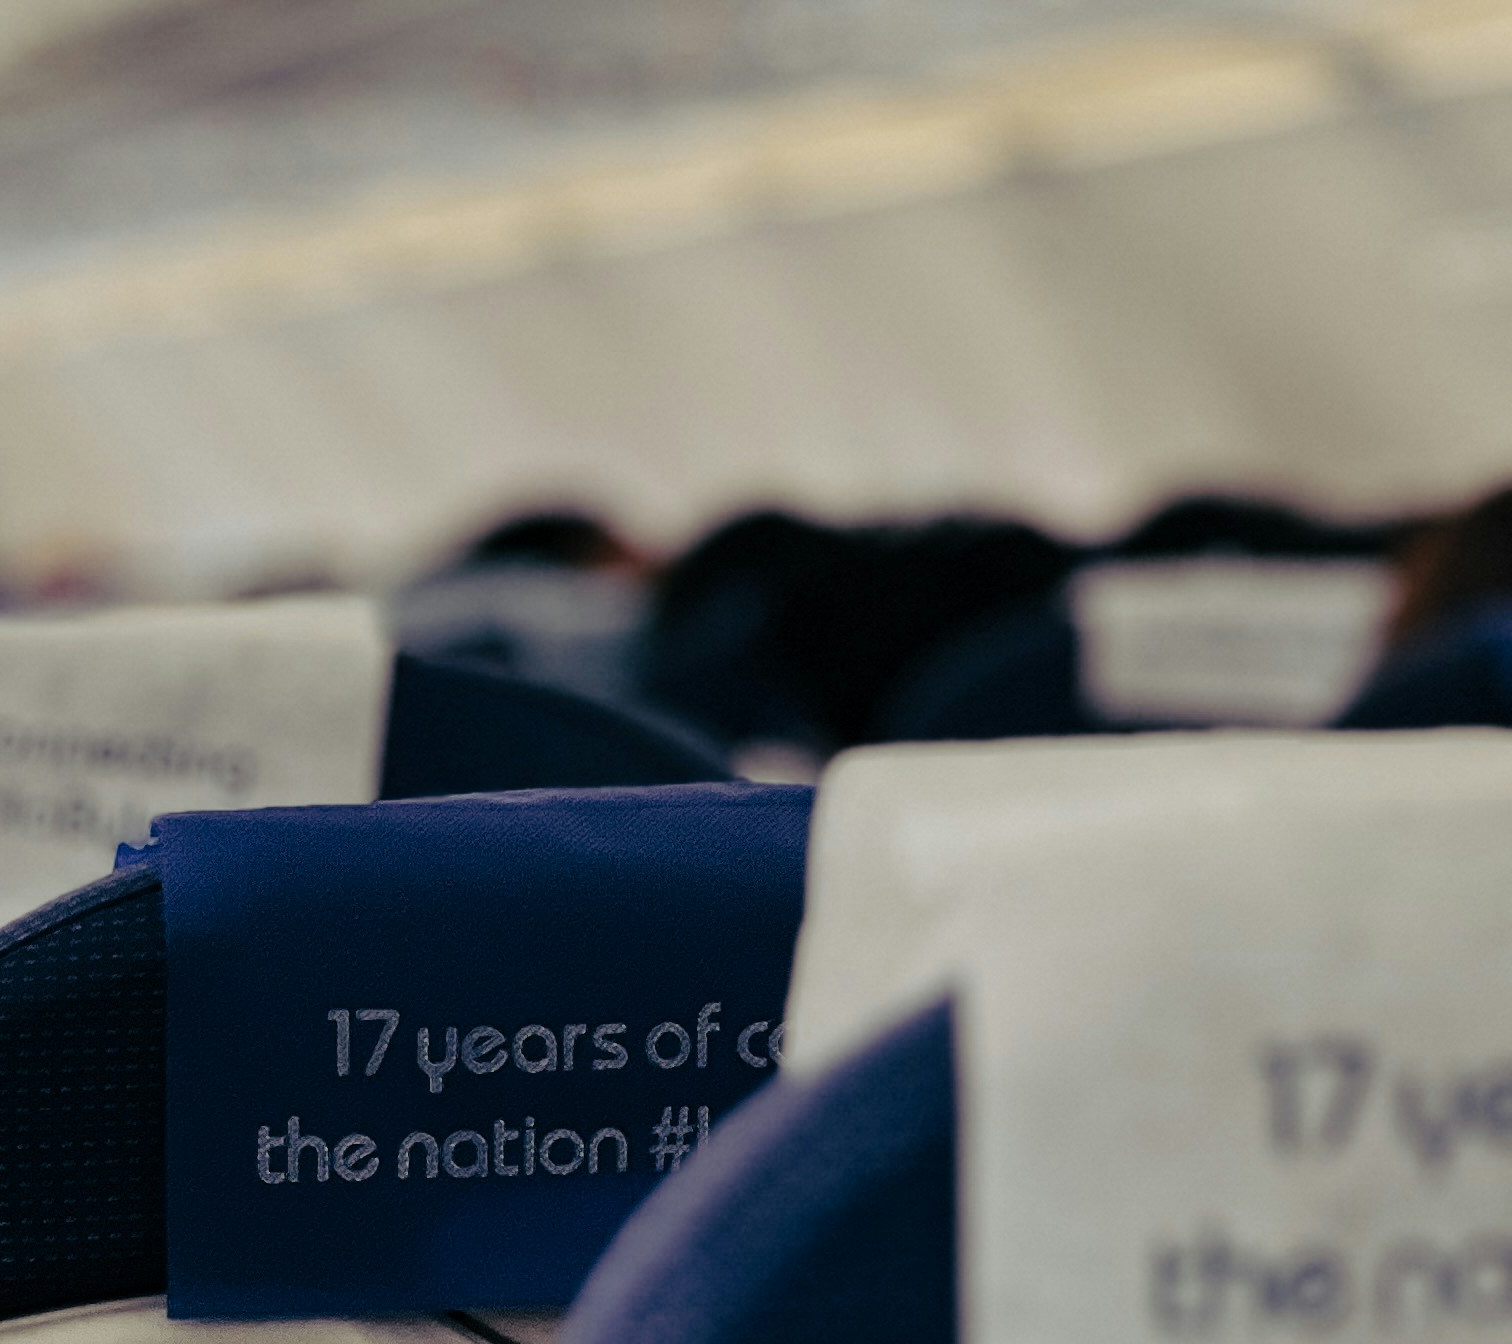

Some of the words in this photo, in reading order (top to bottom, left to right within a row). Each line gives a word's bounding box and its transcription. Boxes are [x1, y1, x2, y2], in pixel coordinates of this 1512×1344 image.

[327, 1008, 400, 1077] 17
[416, 1023, 629, 1093] years
[645, 1001, 722, 1069] of
[257, 1115, 380, 1184] the
[397, 1115, 629, 1179] nation
